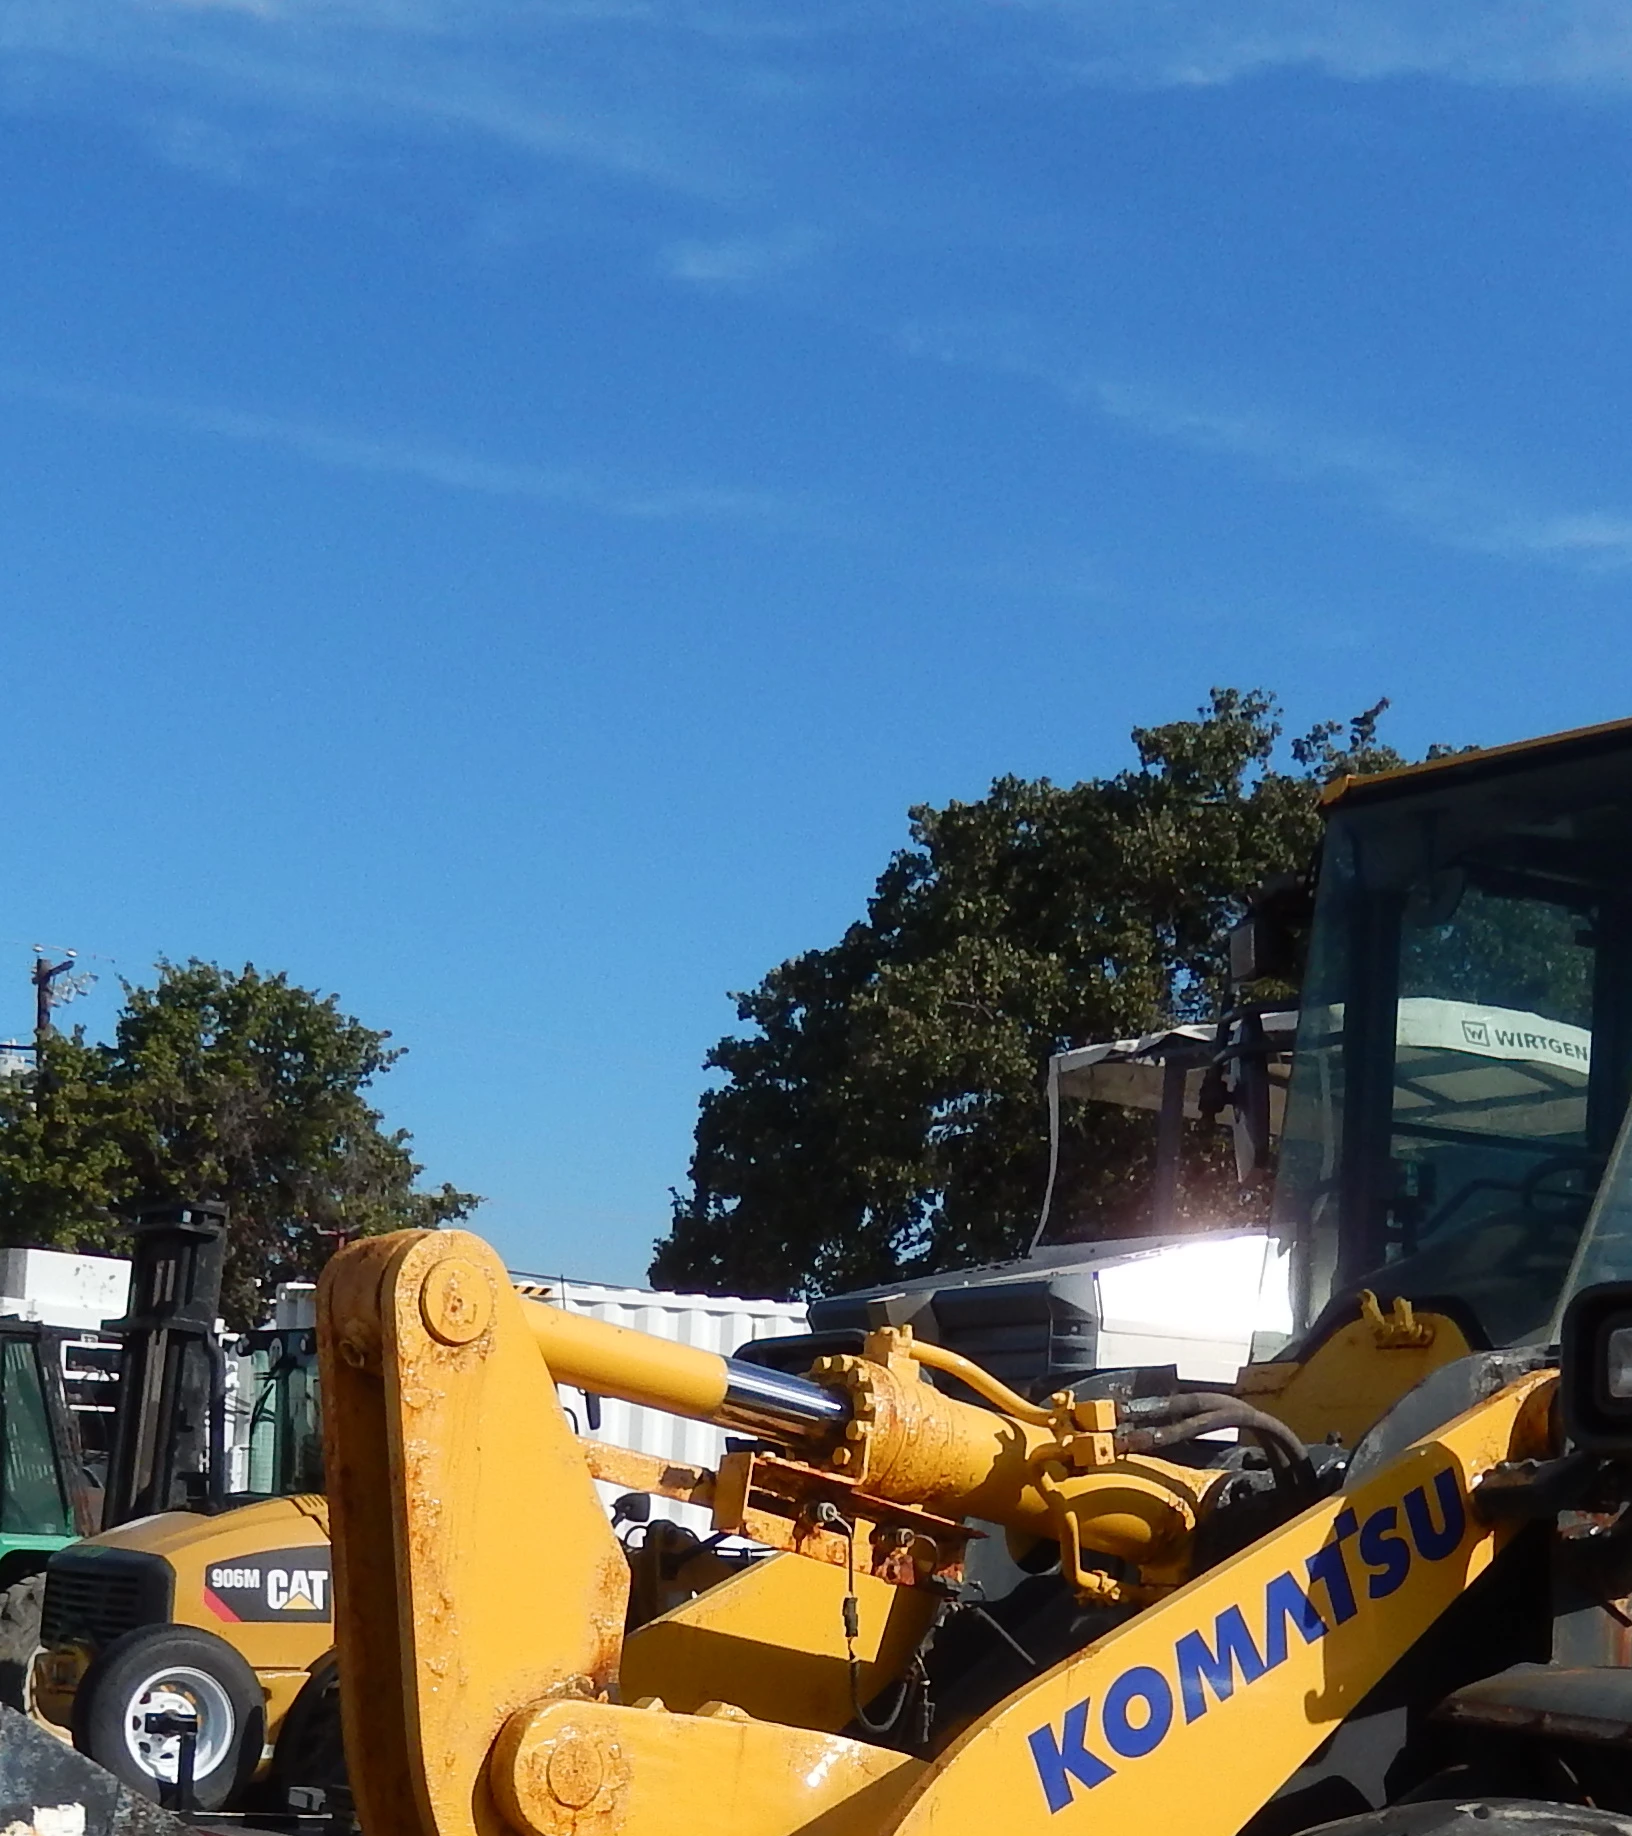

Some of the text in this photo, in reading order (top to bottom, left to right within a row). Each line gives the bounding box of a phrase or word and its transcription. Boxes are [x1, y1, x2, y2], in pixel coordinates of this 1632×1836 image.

[1494, 1028, 1588, 1061] WIRTGEN
[212, 1568, 329, 1610] 906M CAT
[1027, 1465, 1467, 1815] KOMATSU
